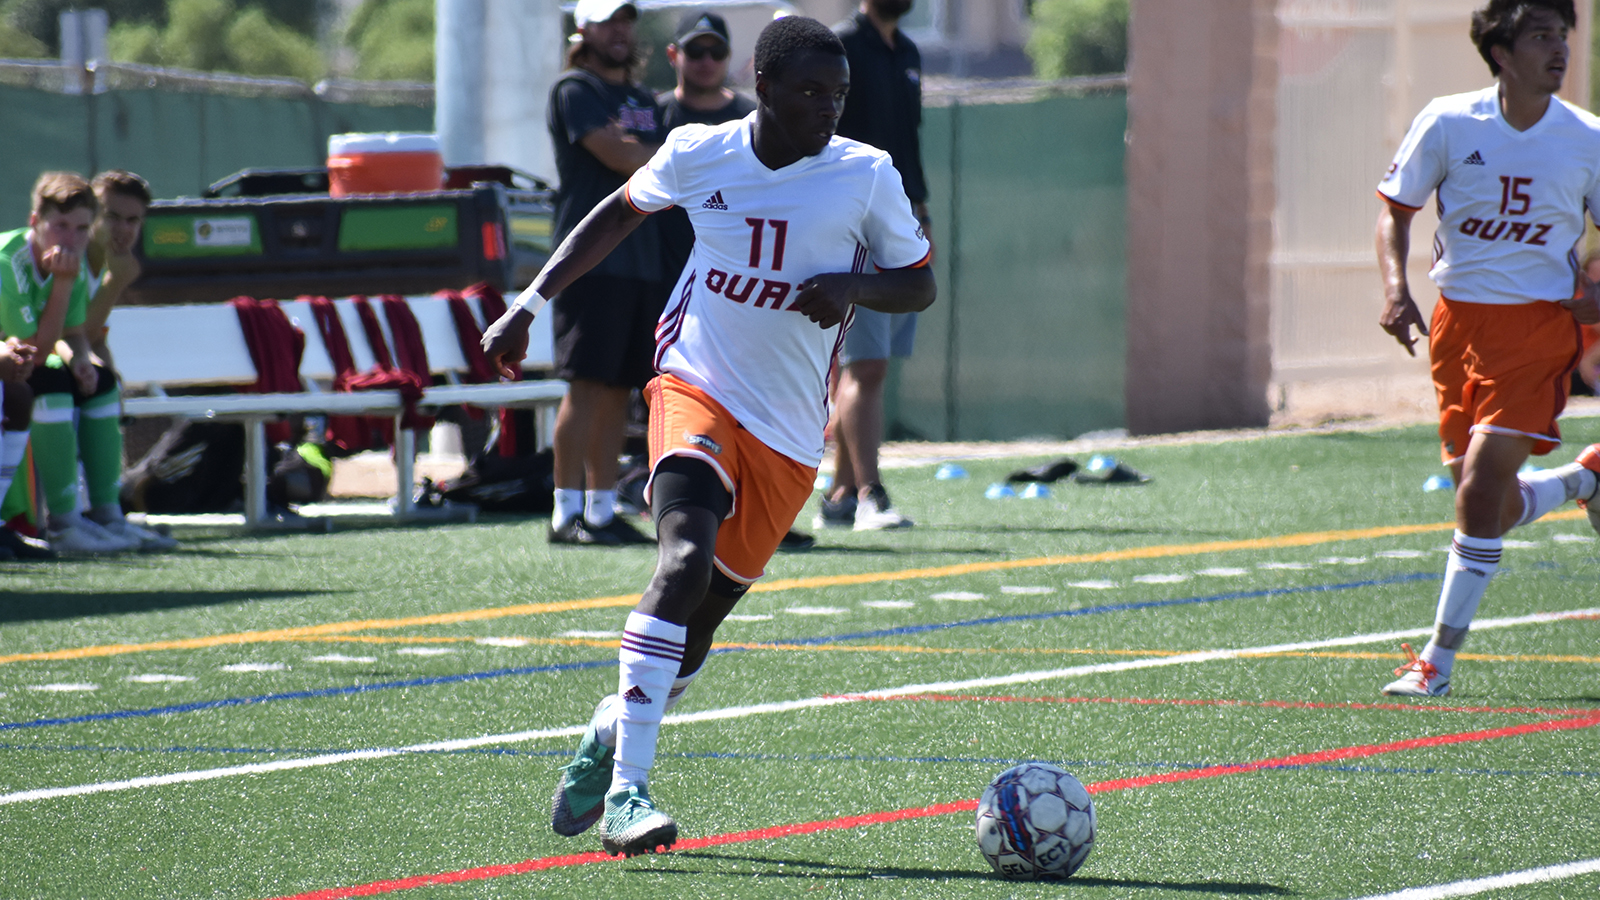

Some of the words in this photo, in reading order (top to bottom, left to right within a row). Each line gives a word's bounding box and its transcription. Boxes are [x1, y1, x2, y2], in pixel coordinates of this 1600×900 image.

[702, 202, 728, 210] adidas
[1499, 176, 1533, 215] 15
[745, 217, 788, 271] 11
[1459, 217, 1553, 246] QUAZ
